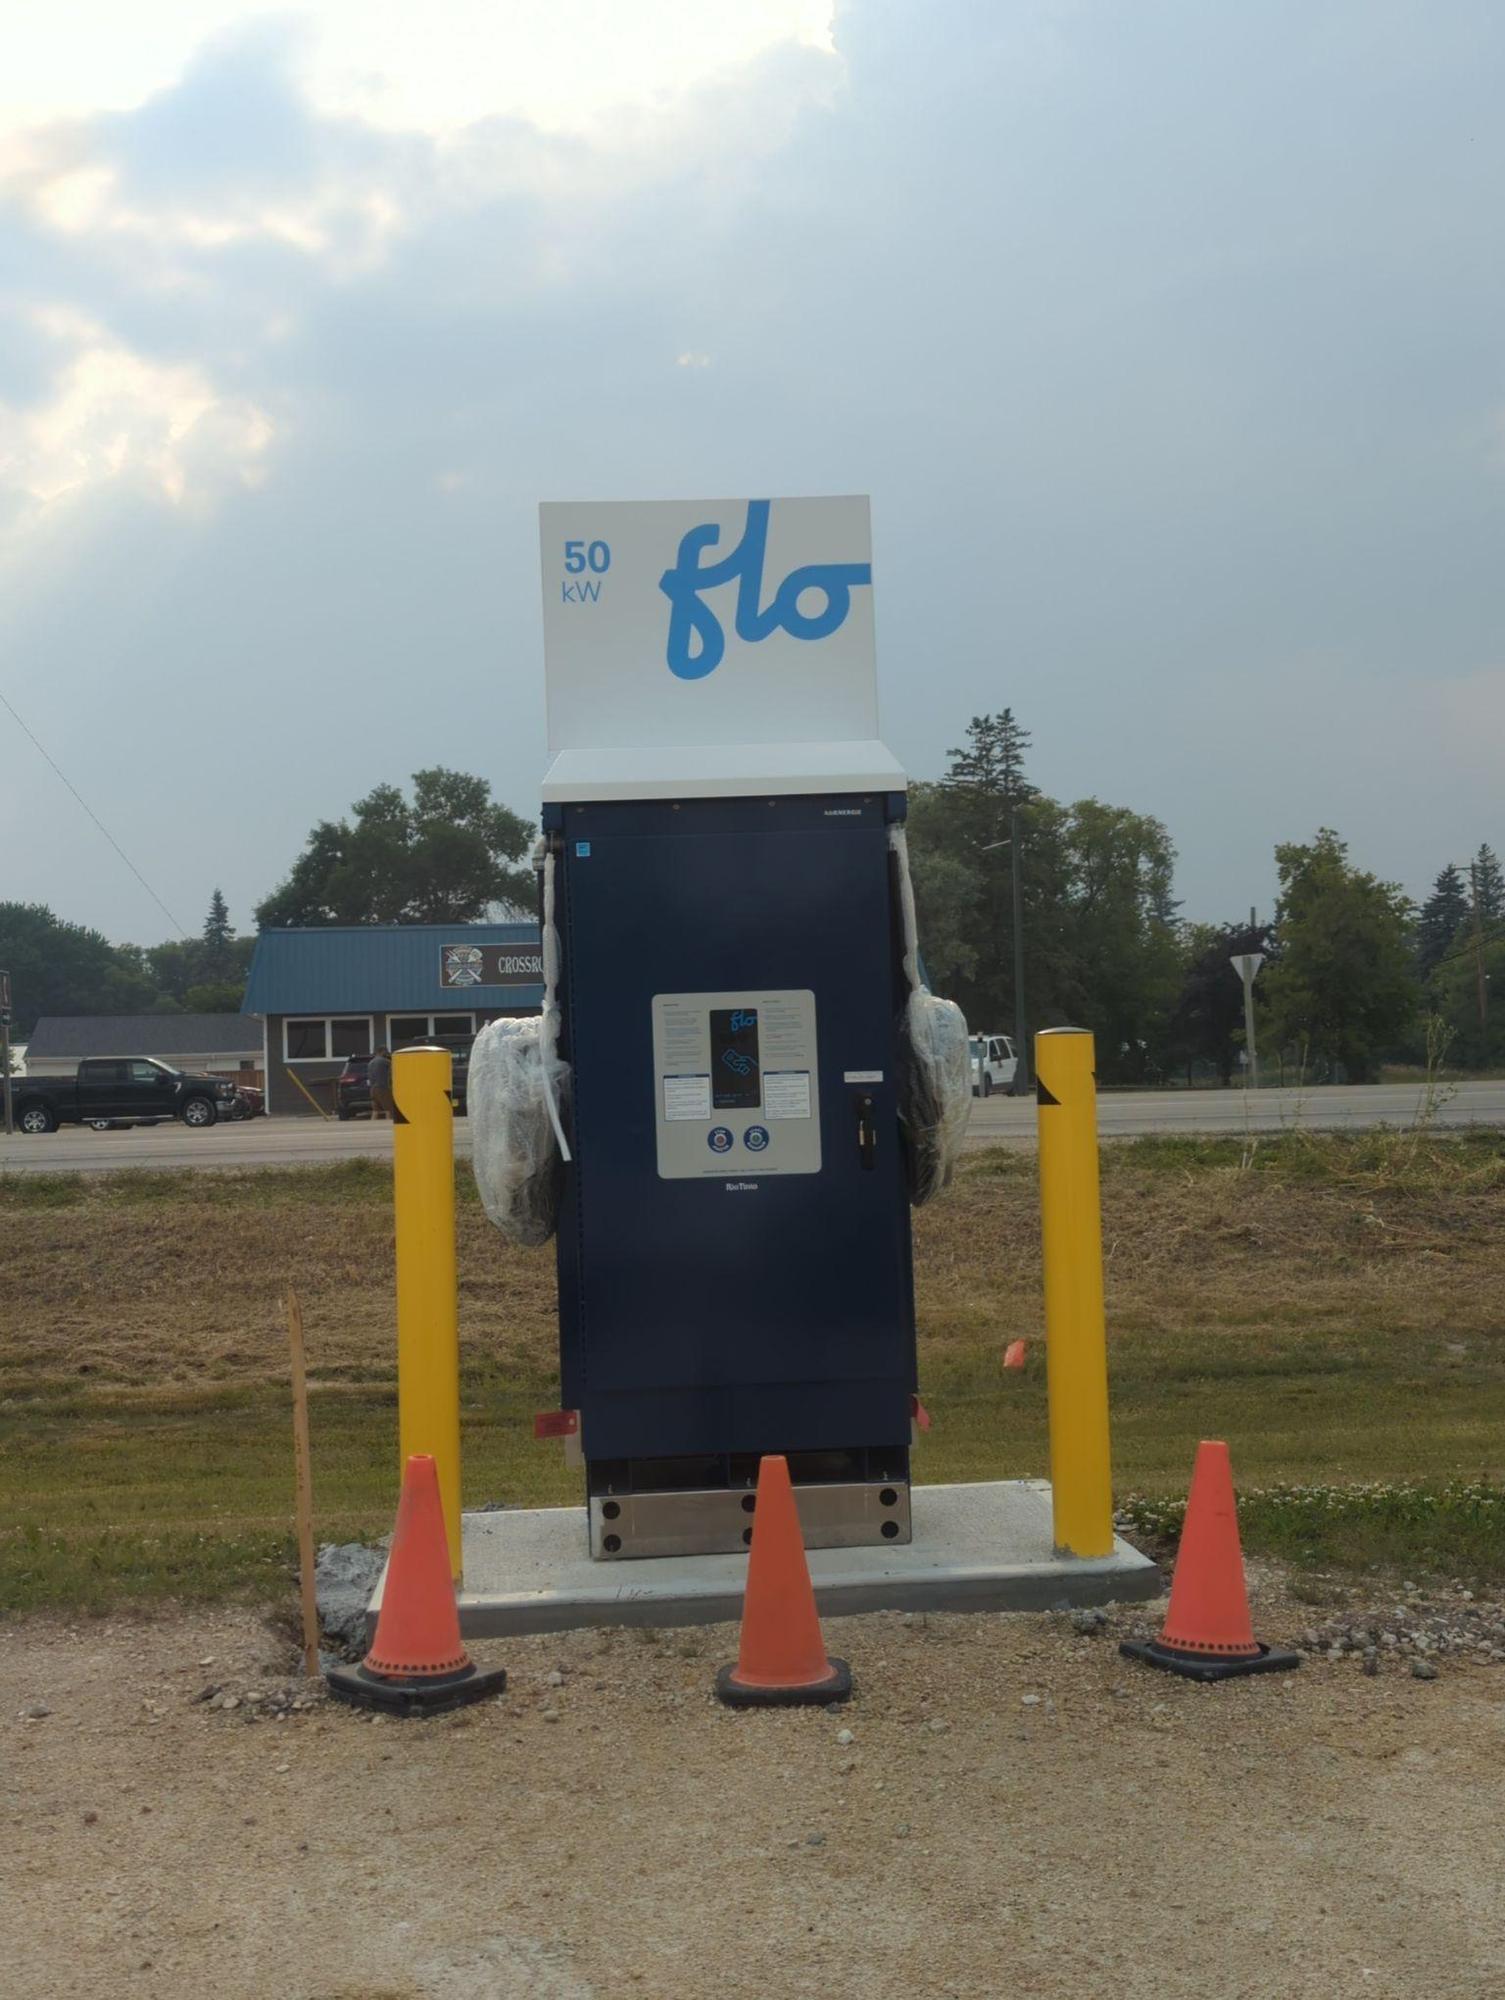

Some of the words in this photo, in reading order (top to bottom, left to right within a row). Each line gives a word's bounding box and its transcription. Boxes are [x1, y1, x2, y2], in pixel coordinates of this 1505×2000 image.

[564, 540, 610, 573] 50
[561, 580, 602, 602] kW
[659, 499, 872, 681] flo
